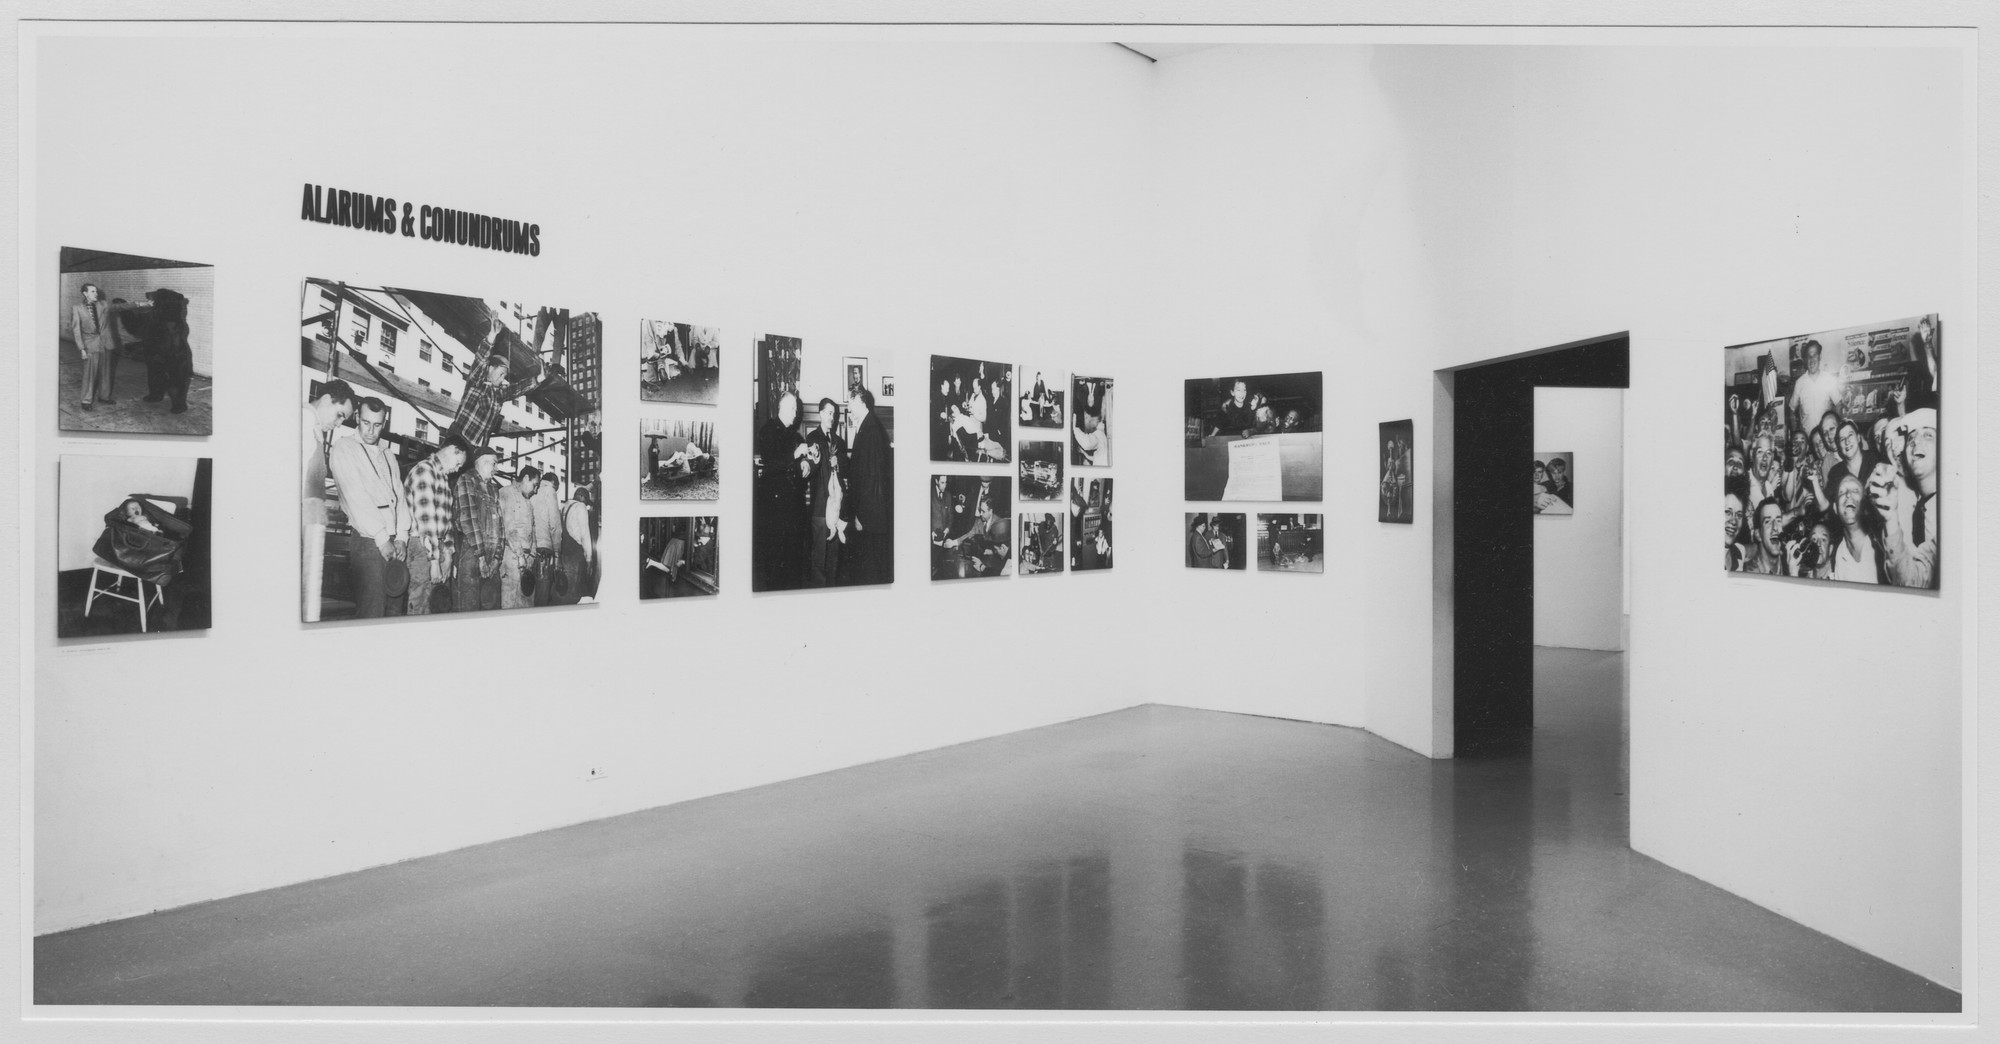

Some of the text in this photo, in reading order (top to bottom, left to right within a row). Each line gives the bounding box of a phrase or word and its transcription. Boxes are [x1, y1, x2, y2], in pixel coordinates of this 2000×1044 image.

[301, 183, 540, 257] ALARUMS & CONUNDRUMS
